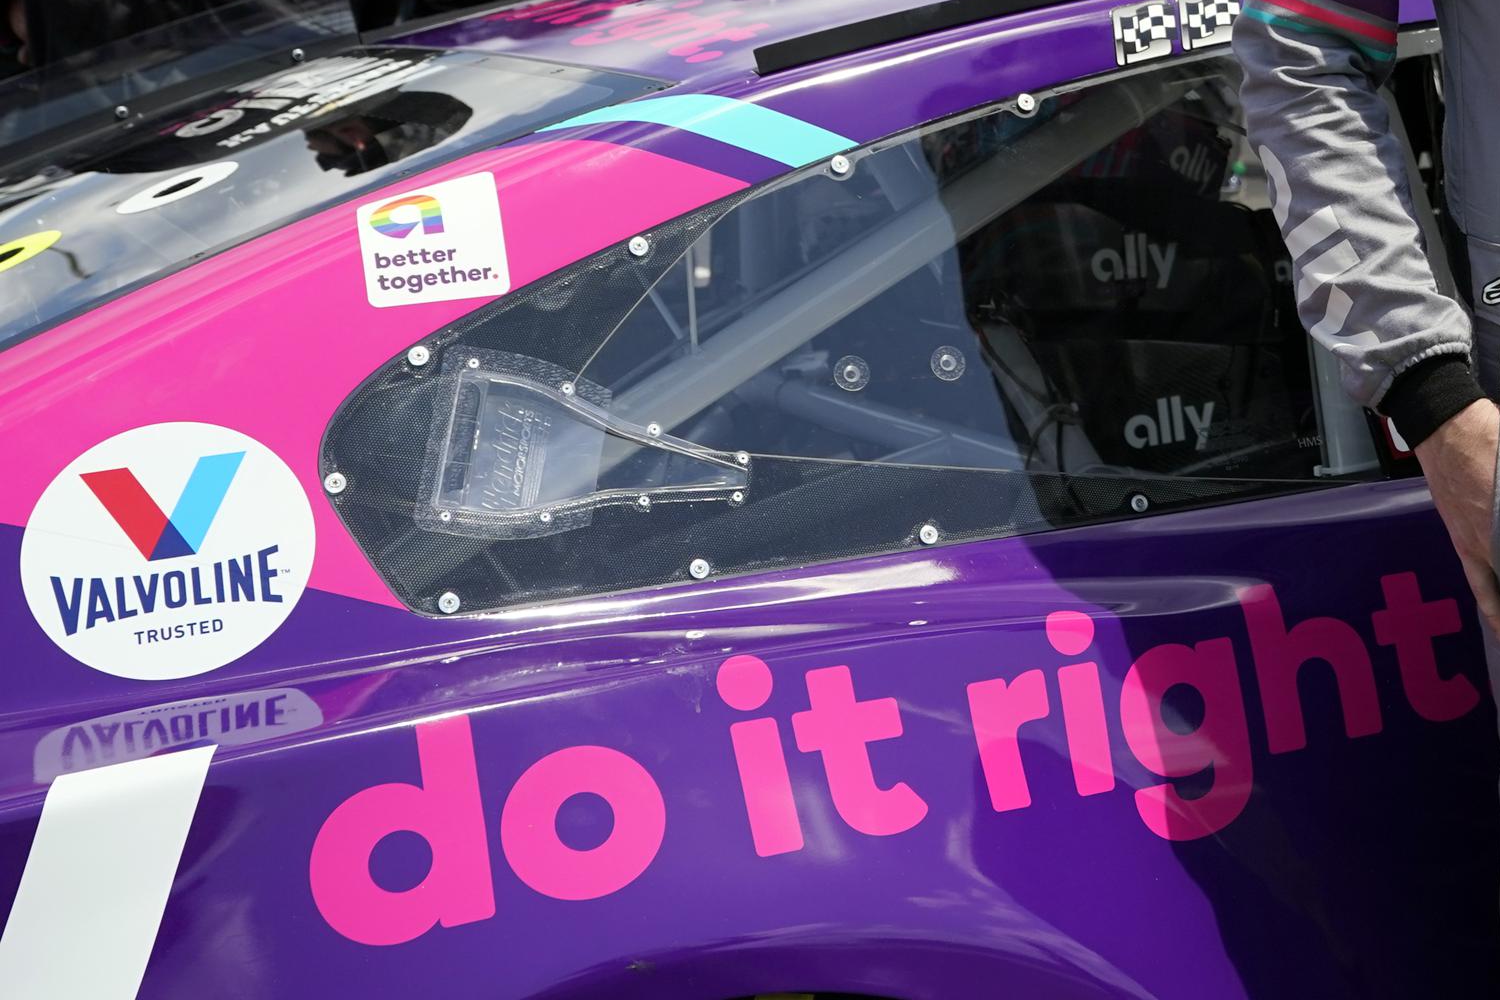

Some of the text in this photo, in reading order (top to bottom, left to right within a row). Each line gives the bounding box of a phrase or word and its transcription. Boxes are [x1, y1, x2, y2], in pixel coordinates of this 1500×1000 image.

[374, 249, 457, 269] better
[377, 266, 499, 293] together.
[1091, 233, 1178, 288] ally
[1124, 395, 1215, 450] ally
[50, 545, 283, 636] VALVOLINE
[134, 619, 223, 645] TRUSTED
[309, 714, 666, 946] do
[716, 654, 929, 857] it
